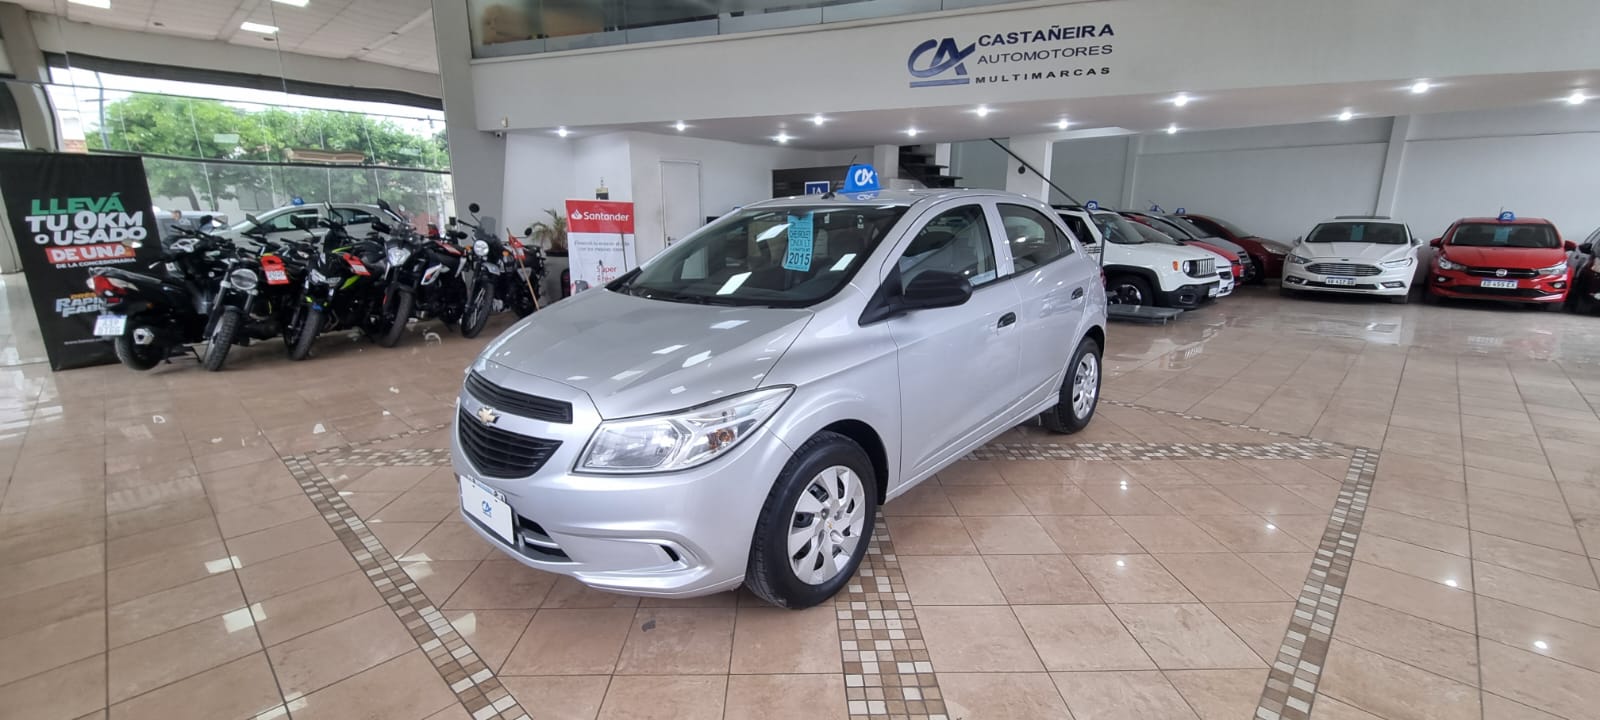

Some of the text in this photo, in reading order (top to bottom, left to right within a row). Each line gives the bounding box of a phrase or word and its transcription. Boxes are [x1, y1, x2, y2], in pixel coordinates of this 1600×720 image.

[978, 24, 1114, 47] CASTAÑEIRA
[977, 45, 1113, 65] AUTOMOTORES
[975, 67, 1111, 84] MULTIMARCAS
[31, 192, 125, 215] LLEVÁ
[25, 214, 69, 233] TU
[583, 211, 630, 221] Santander
[53, 227, 148, 246] USADO
[51, 248, 80, 262] DE
[788, 252, 810, 266] 2015
